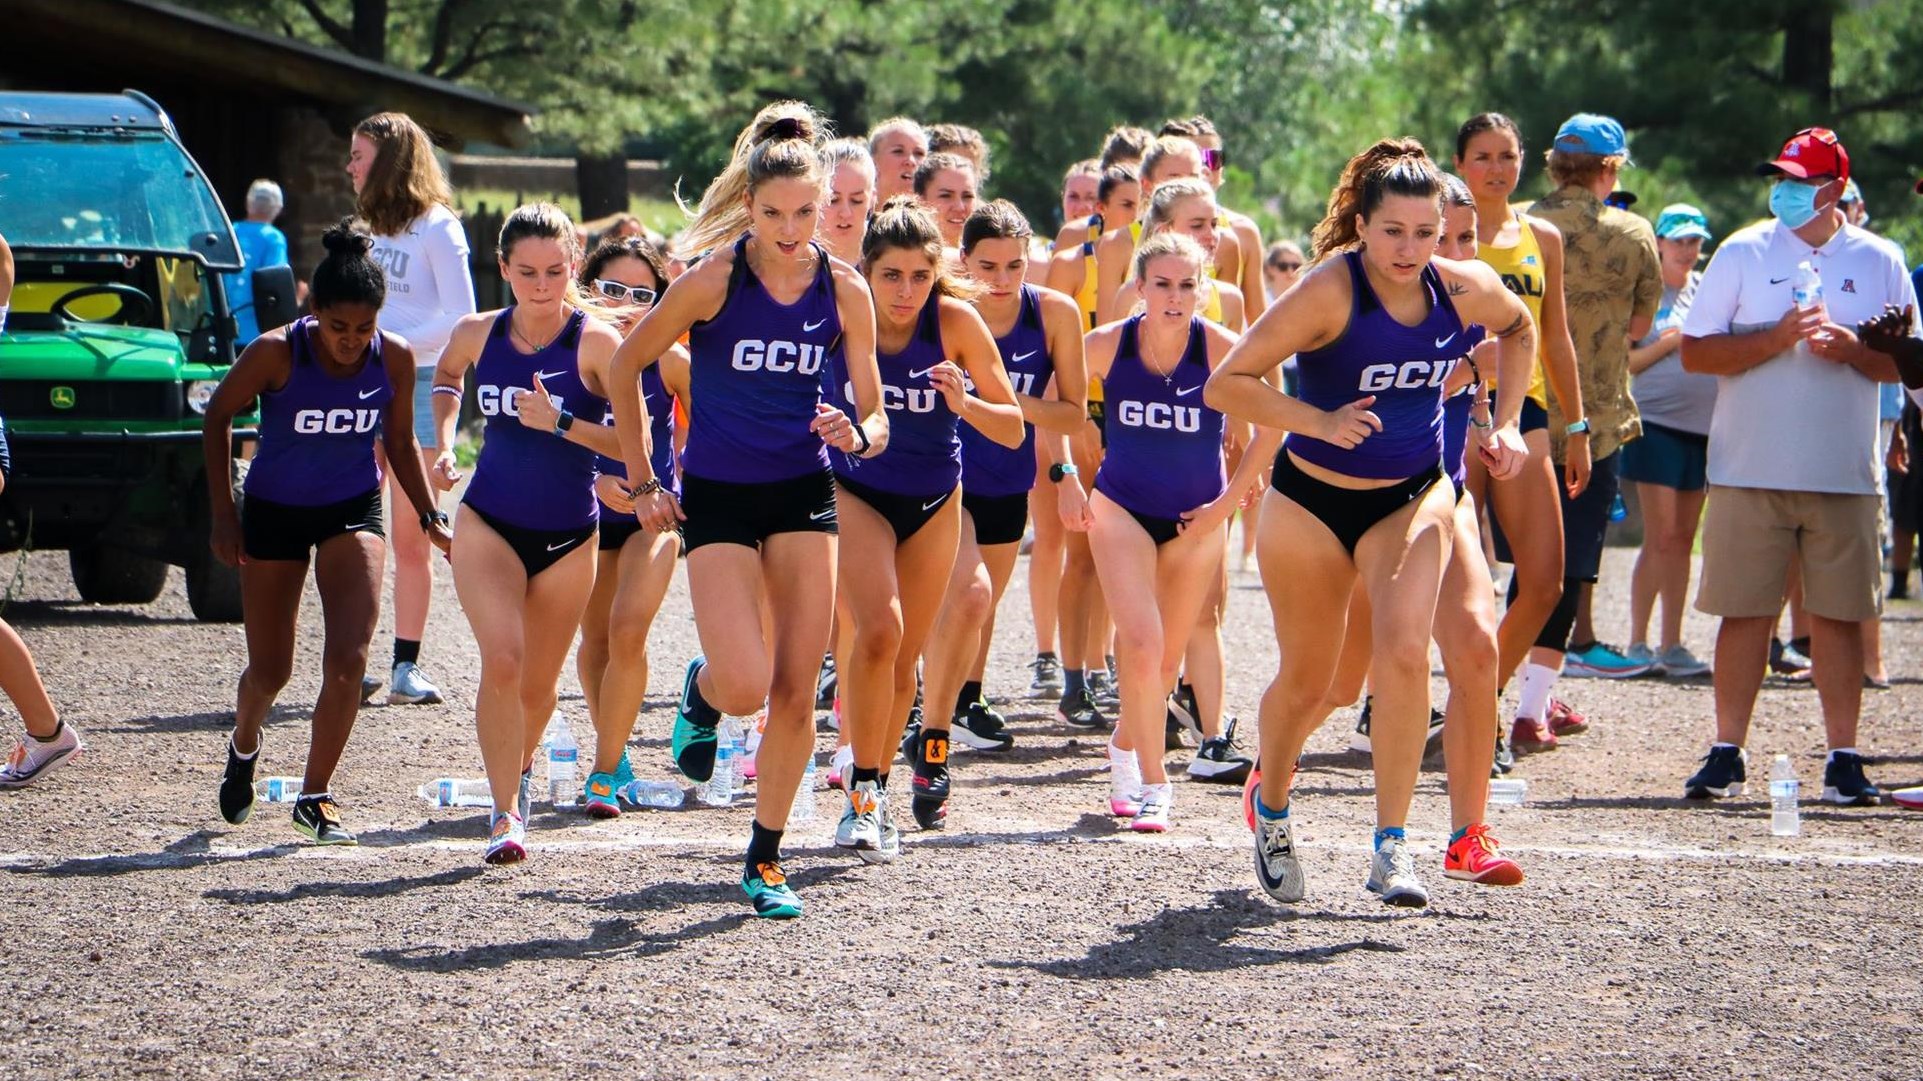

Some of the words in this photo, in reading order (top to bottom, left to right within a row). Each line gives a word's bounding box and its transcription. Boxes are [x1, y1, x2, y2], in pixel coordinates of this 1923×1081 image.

[1841, 279, 1856, 293] A
[731, 339, 825, 375] GCU
[1358, 360, 1457, 391] GCU
[477, 384, 565, 417] GC
[844, 382, 936, 413] CU
[294, 408, 379, 434] GCU
[1119, 400, 1201, 433] GCU
